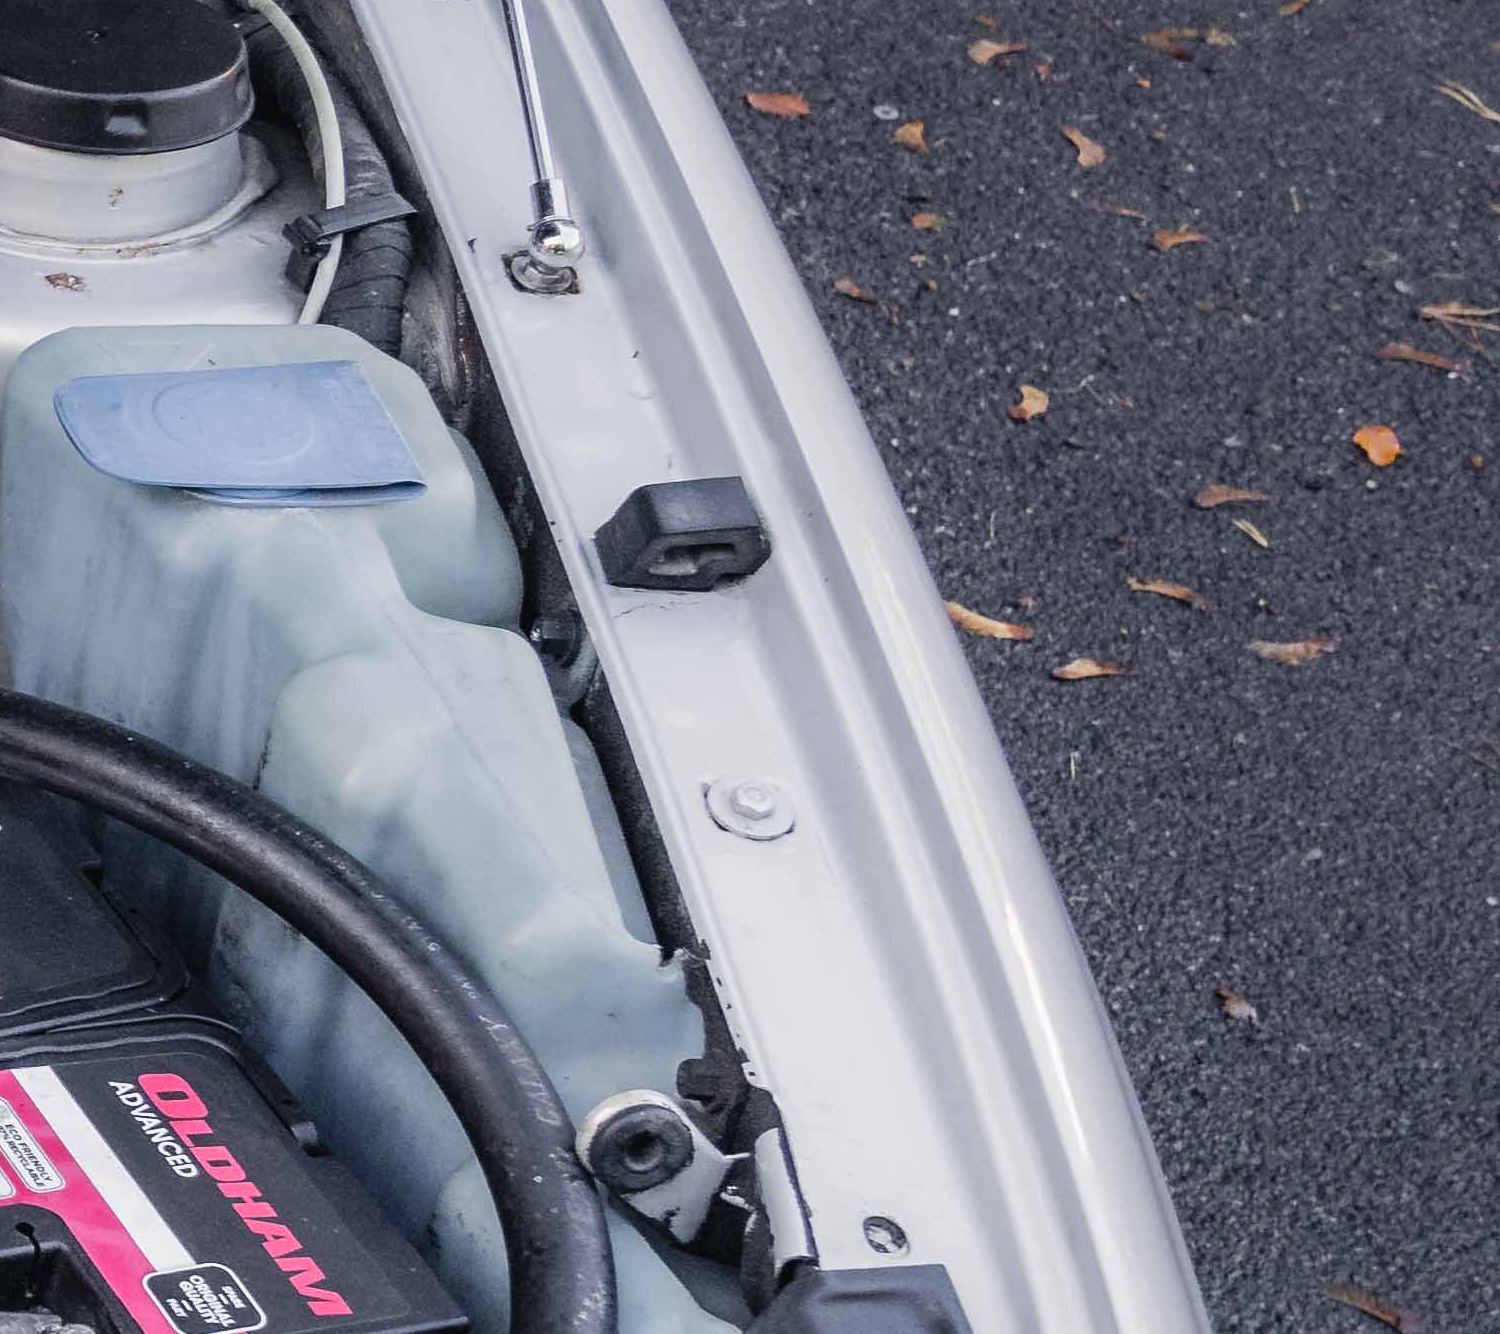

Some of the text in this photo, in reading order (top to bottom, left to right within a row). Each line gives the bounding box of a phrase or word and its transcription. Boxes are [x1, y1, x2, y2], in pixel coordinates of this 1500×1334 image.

[4, 1122, 54, 1183] ECO FRIENDLY
[107, 1079, 199, 1180] ADVANCED
[137, 1073, 354, 1317] OLDHAM
[178, 1280, 221, 1326] QUALITY
[187, 1273, 238, 1328] ORIGINAL
